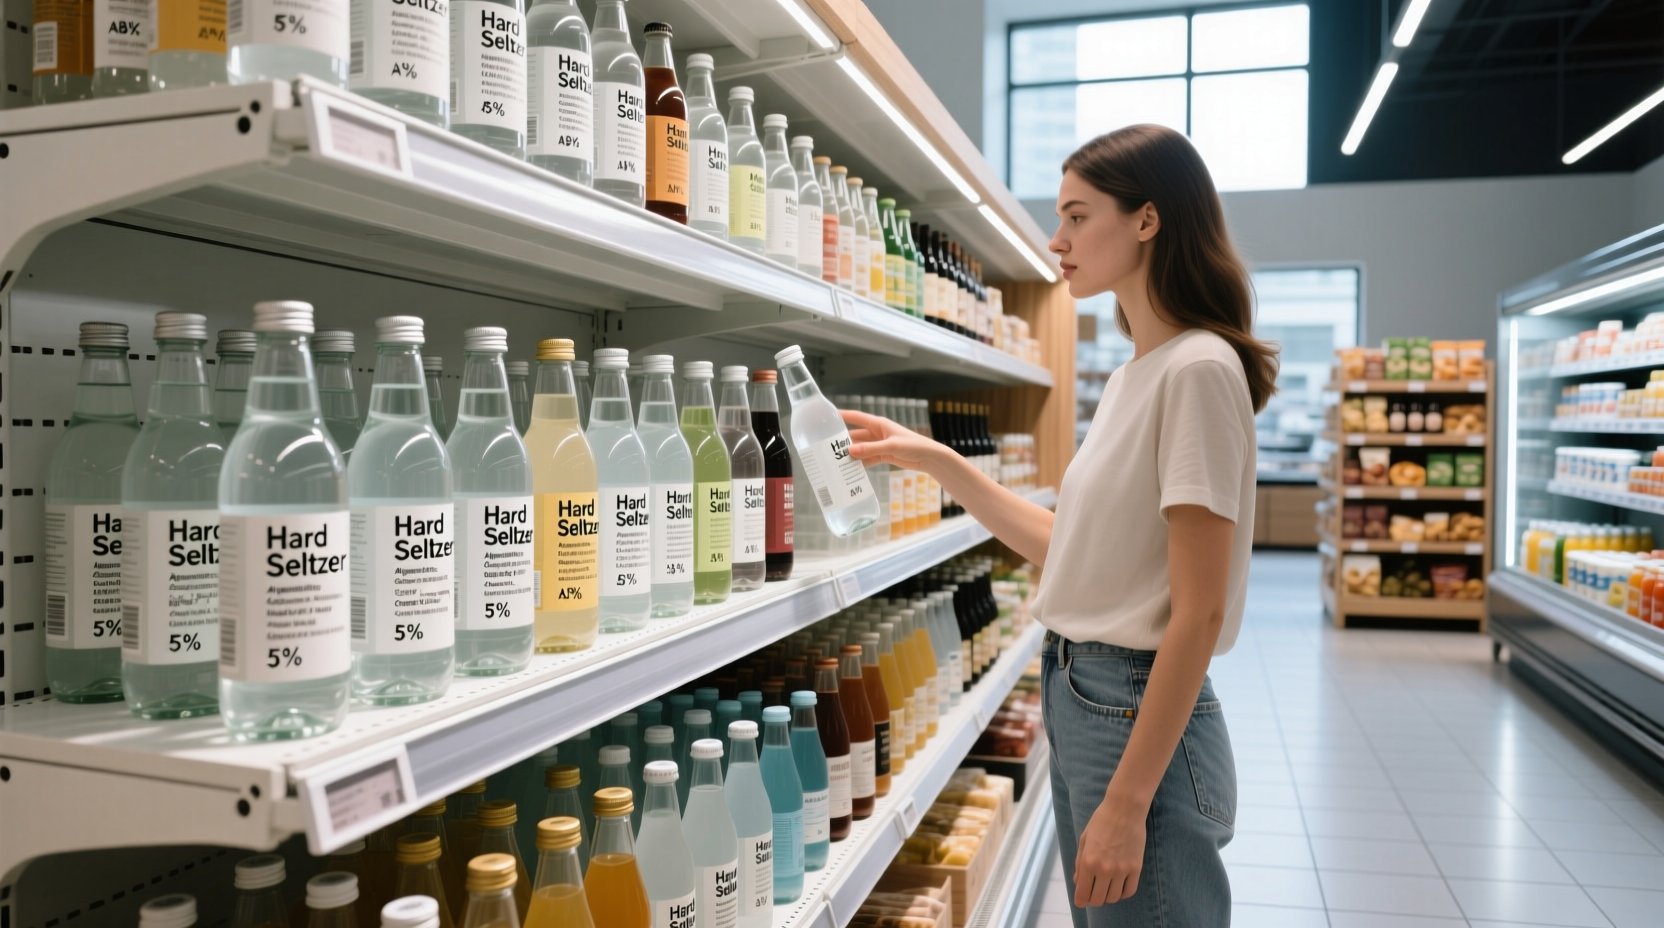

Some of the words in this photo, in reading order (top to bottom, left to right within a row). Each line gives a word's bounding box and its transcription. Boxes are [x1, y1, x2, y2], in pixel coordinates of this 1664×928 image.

[274, 14, 307, 33] 5%
[481, 9, 520, 37] Hard
[558, 498, 594, 517] Hard
[616, 493, 647, 511] Hard
[394, 512, 444, 537] Hard
[484, 503, 527, 526] Hard
[267, 523, 328, 550] Hard
[266, 552, 347, 577] Seltzer
[484, 601, 511, 619] 5%
[92, 618, 122, 638] 5%
[394, 622, 424, 642] 5%
[169, 632, 202, 652] 5%
[266, 646, 303, 669] 5%
